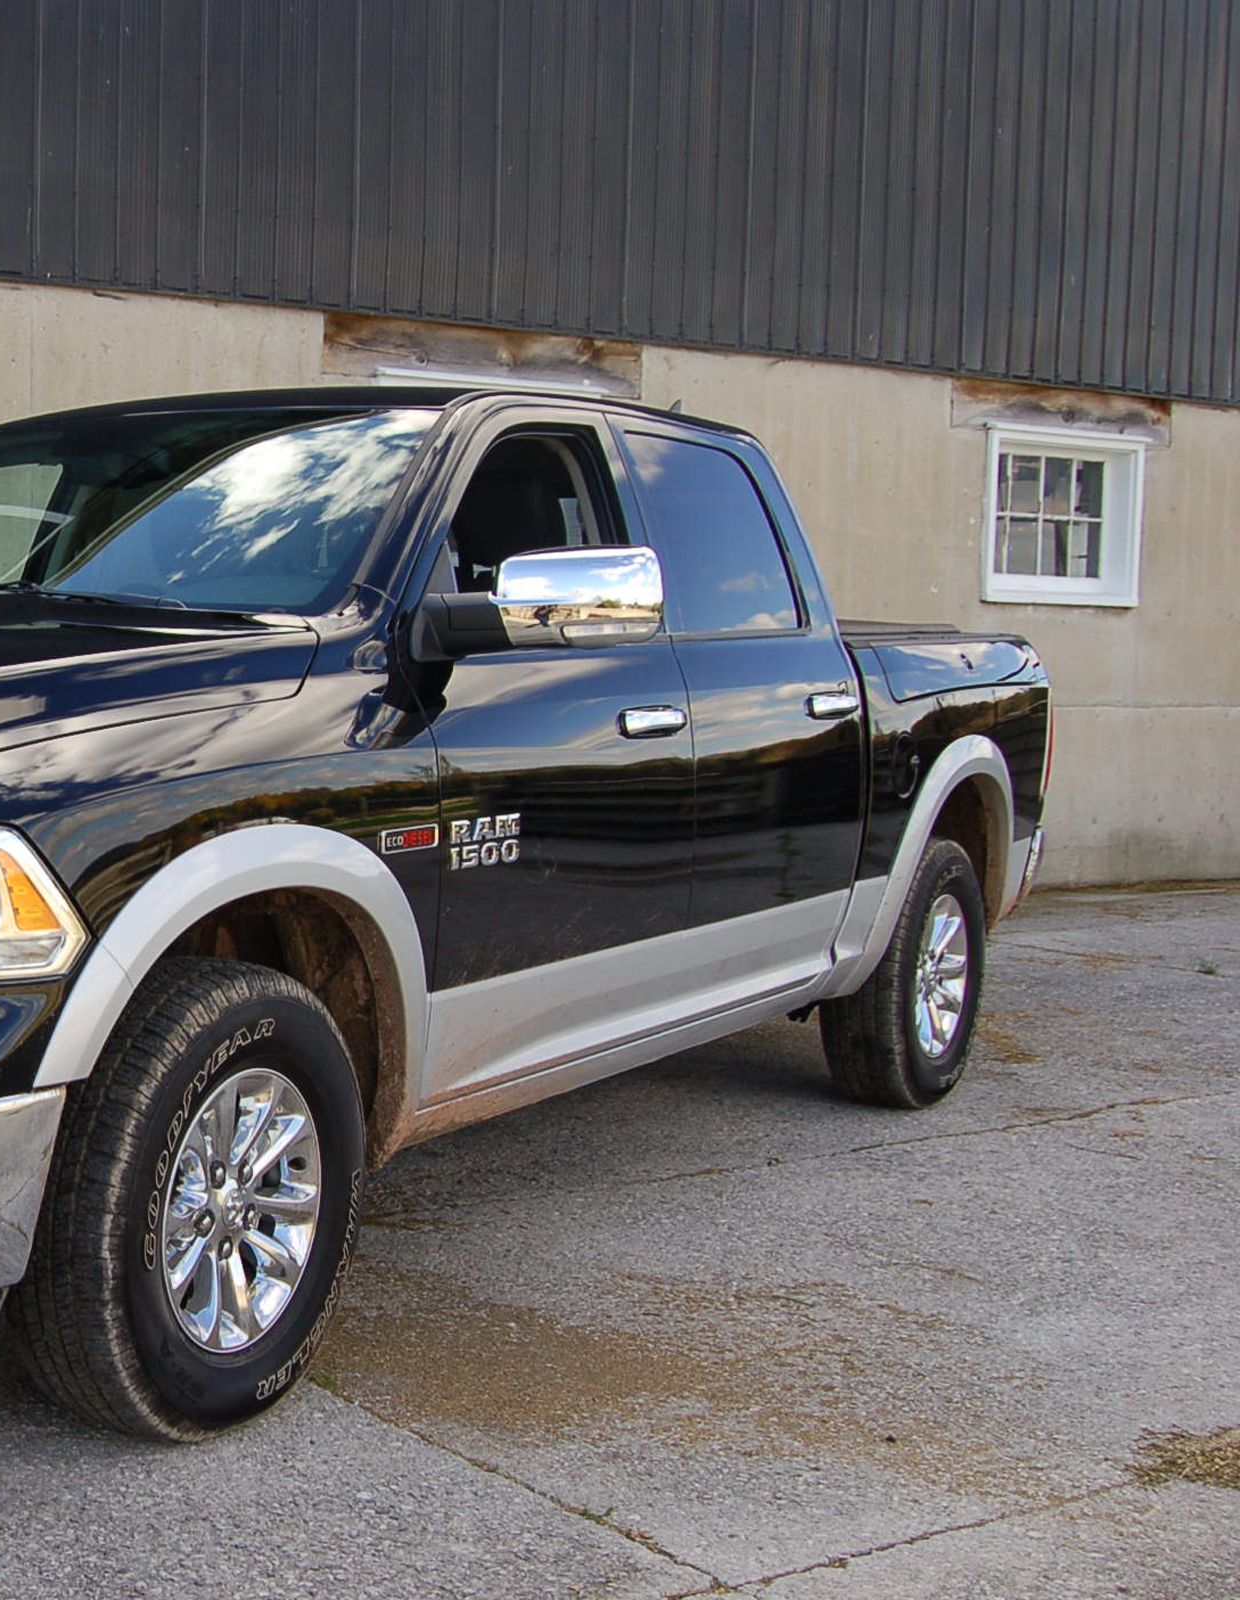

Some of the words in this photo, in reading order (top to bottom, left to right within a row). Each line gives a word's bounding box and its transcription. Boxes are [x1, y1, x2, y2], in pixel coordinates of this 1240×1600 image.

[385, 828, 433, 848] ECODIESEL
[450, 812, 521, 844] RAM
[450, 839, 520, 870] 1500
[144, 1019, 275, 1270] GOODYEAR
